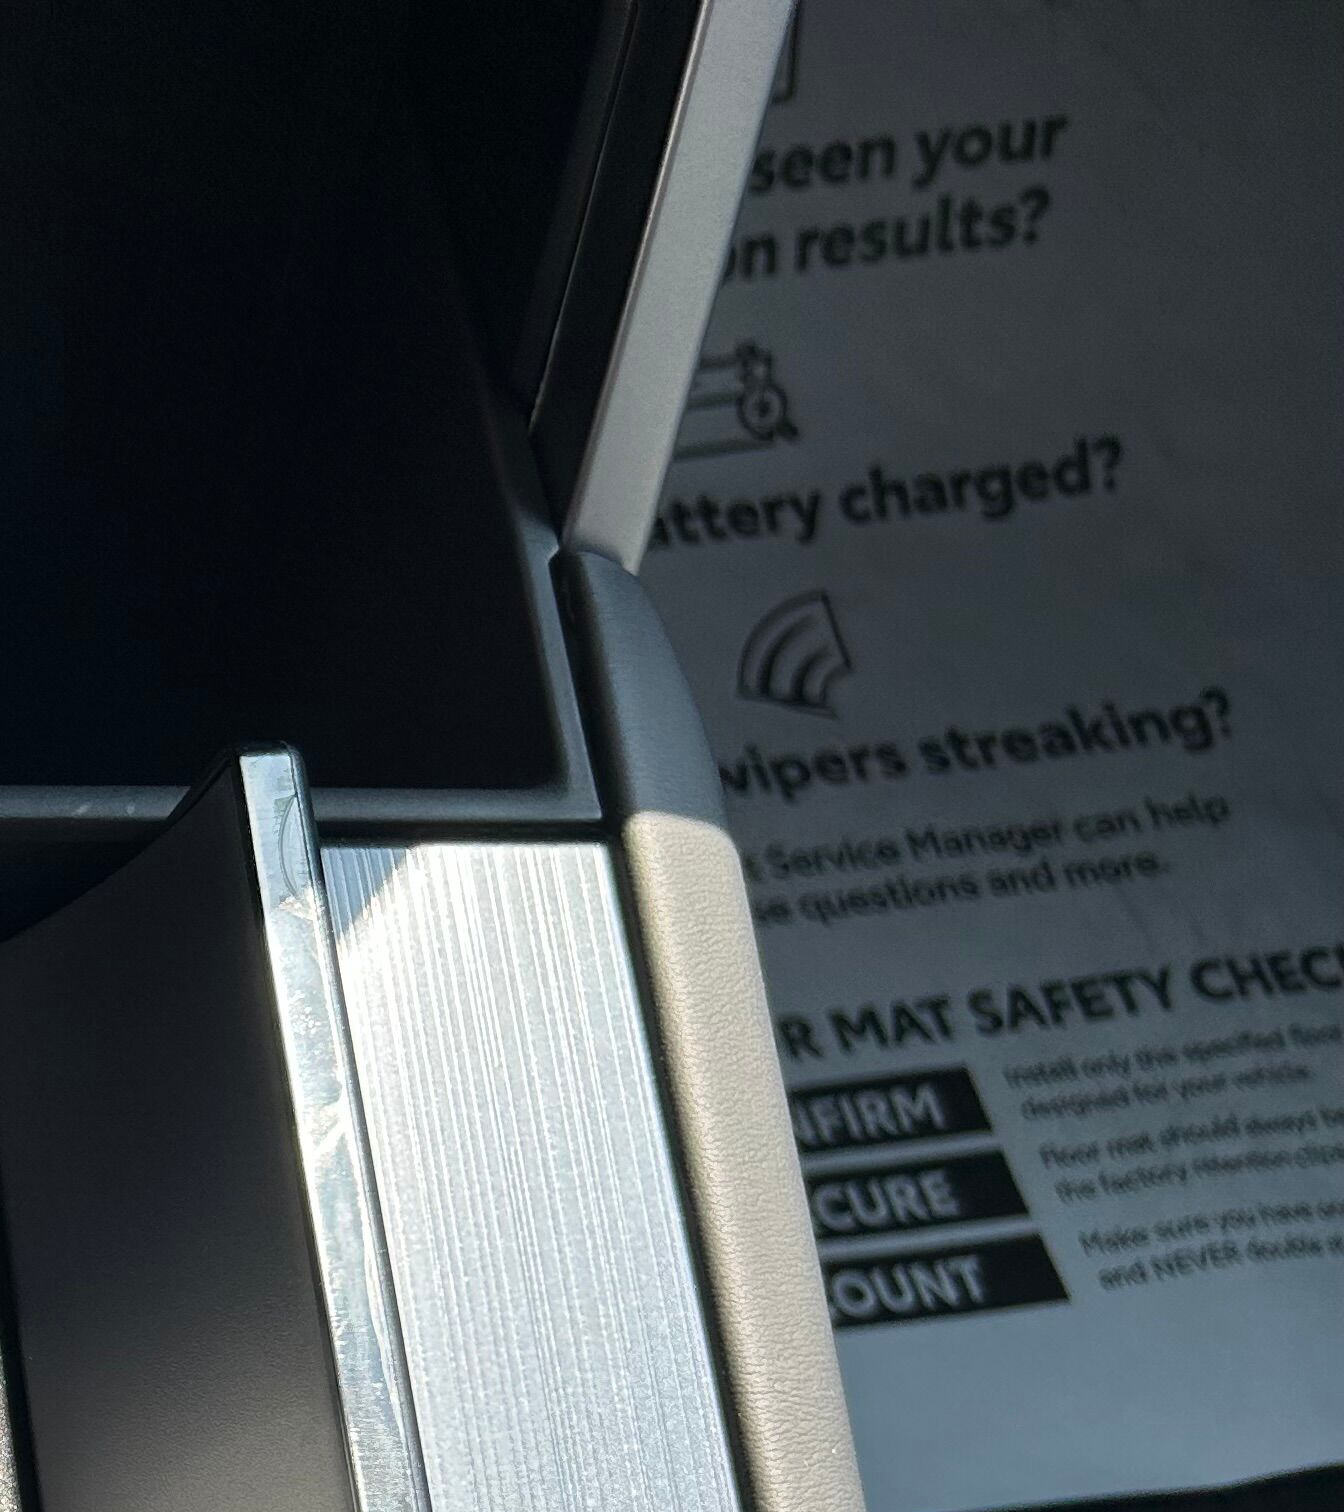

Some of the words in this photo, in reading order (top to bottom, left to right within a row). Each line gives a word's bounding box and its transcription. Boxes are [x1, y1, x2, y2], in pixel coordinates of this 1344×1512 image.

[749, 131, 896, 194] seen
[911, 113, 1069, 191] your
[795, 185, 1051, 275] results?
[838, 432, 1124, 524] charged?
[919, 684, 1231, 774] streaking?
[1073, 807, 1140, 844] can
[1143, 795, 1229, 830] help
[986, 855, 1056, 896] and
[827, 994, 955, 1055] MAT
[967, 962, 1174, 1036] SAFETY
[811, 1168, 960, 1232] CURE
[830, 1255, 984, 1319] OUNT
